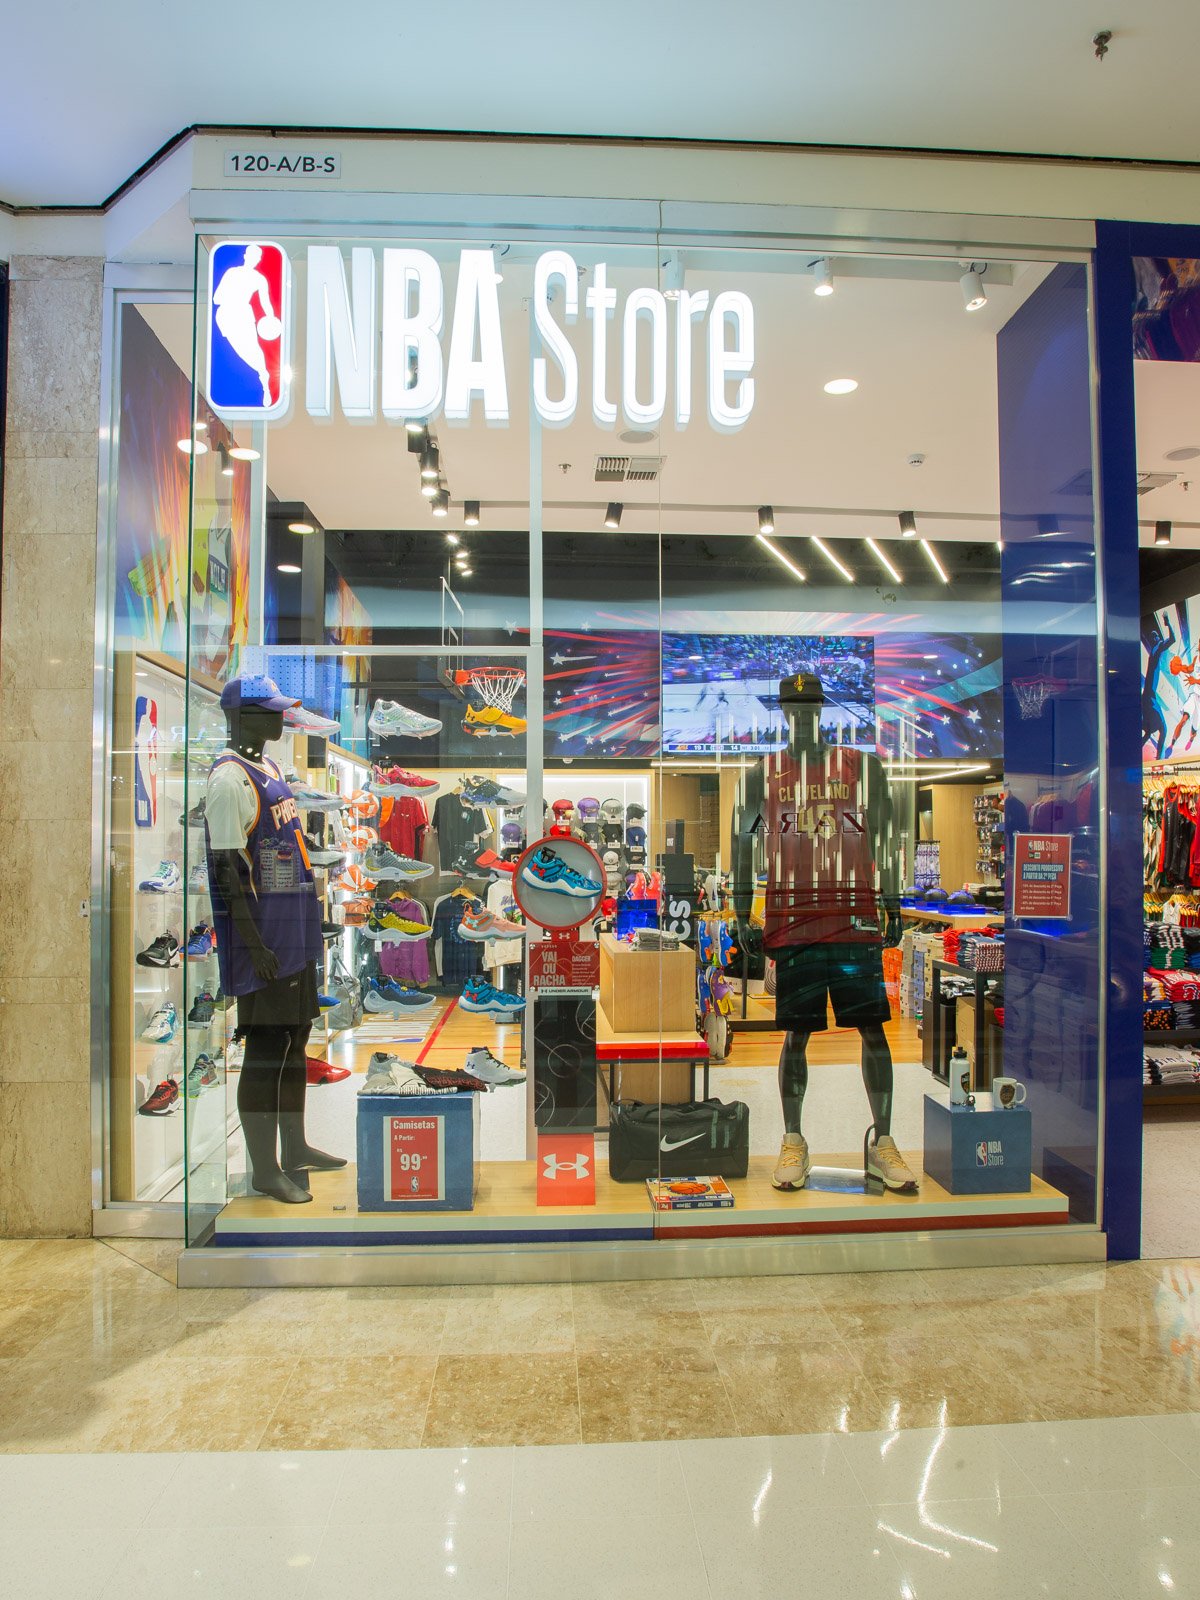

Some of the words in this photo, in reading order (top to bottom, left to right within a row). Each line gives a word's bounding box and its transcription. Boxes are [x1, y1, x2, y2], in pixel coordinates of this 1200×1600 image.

[230, 155, 336, 174] 120-A/B-S
[305, 245, 511, 421] NBA
[532, 250, 755, 427] Store
[1033, 840, 1045, 852] NBA
[542, 951, 557, 962] VAI
[543, 963, 556, 974] OU
[533, 974, 566, 986] RACHA
[393, 1120, 436, 1129] Camisetas
[988, 1140, 1002, 1153] NBA
[988, 1154, 1004, 1166] Store
